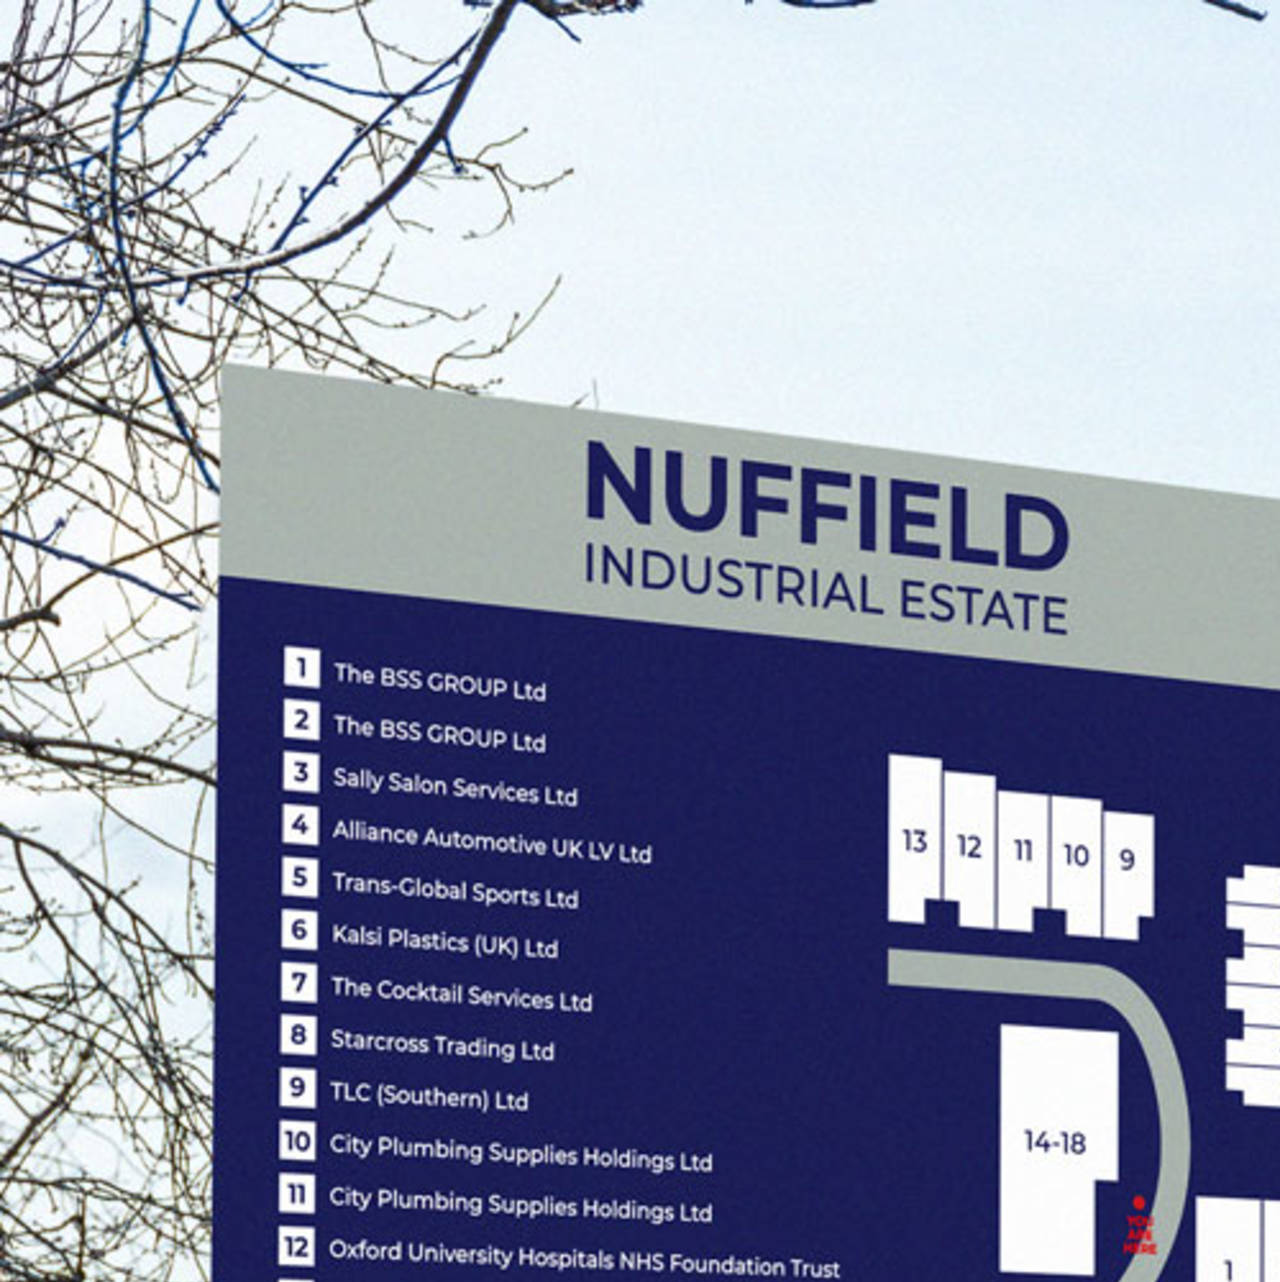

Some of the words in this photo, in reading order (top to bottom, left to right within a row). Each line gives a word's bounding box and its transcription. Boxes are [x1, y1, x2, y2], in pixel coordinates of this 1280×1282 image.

[587, 440, 1069, 571] NUFFIELD
[586, 542, 885, 615] INDUSTRIAL
[901, 579, 1068, 636] ESTATE
[296, 657, 306, 678] 1
[333, 661, 376, 685] The
[380, 666, 423, 691] BSS
[426, 671, 508, 698] GROUP
[513, 680, 547, 703] Ltd
[294, 708, 309, 731] 2
[333, 713, 375, 738] The
[379, 718, 423, 742] BSS
[426, 723, 508, 749] GROUP
[512, 731, 547, 754] Ltd
[294, 761, 309, 783] 3
[333, 766, 385, 795] Sally
[388, 771, 448, 796] Salon
[452, 777, 540, 805] Services
[544, 785, 579, 808] Ltd
[291, 813, 309, 835] 4
[331, 819, 419, 846] Alliance
[421, 827, 548, 856] Automotive
[552, 837, 585, 859] UK
[588, 841, 615, 862] LV
[618, 843, 653, 865] Ltd
[903, 828, 928, 853] 13
[957, 834, 982, 859] 12
[1014, 839, 1032, 861] 11
[1064, 843, 1089, 867] 10
[1120, 848, 1135, 871] 9
[292, 866, 308, 888] 5
[331, 871, 468, 901] Trans-Global
[472, 882, 541, 908] Sports
[544, 888, 580, 910] Ltd
[291, 918, 308, 940] 6
[332, 923, 383, 946] Kalsi
[388, 927, 470, 954] Plastics
[474, 933, 519, 961] (UK)
[524, 938, 559, 959] Ltd
[291, 971, 307, 993] 7
[330, 975, 373, 999] The
[376, 979, 463, 1005] Cocktail
[467, 984, 555, 1011] Services
[559, 991, 593, 1013] Ltd
[290, 1023, 307, 1046] 8
[331, 1028, 431, 1054] Starcross
[433, 1034, 516, 1064] Trading
[521, 1040, 556, 1062] Ltd
[289, 1076, 306, 1098] 9
[329, 1080, 372, 1103] TLC
[376, 1083, 490, 1114] (Southern)
[494, 1090, 529, 1112] Ltd
[284, 1130, 311, 1153] 10
[329, 1133, 373, 1160] City
[377, 1135, 484, 1166] Plumbing
[488, 1141, 579, 1168] Supplies
[582, 1146, 676, 1175] Holdings
[679, 1151, 713, 1173] Ltd
[1024, 1128, 1087, 1156] 14-18
[287, 1183, 306, 1204] 11
[329, 1186, 373, 1212] City
[377, 1188, 483, 1217] Plumbing
[488, 1193, 579, 1219] Supplies
[582, 1198, 675, 1226] Holdings
[679, 1202, 713, 1224] Ltd
[284, 1235, 309, 1258] 12
[328, 1238, 403, 1261] Oxford
[407, 1242, 514, 1271] University
[518, 1246, 615, 1272] Hospitals
[619, 1251, 665, 1273] NHS
[669, 1253, 787, 1277] Foundation
[789, 1258, 841, 1279] Trust
[1223, 1259, 1234, 1282] 1
